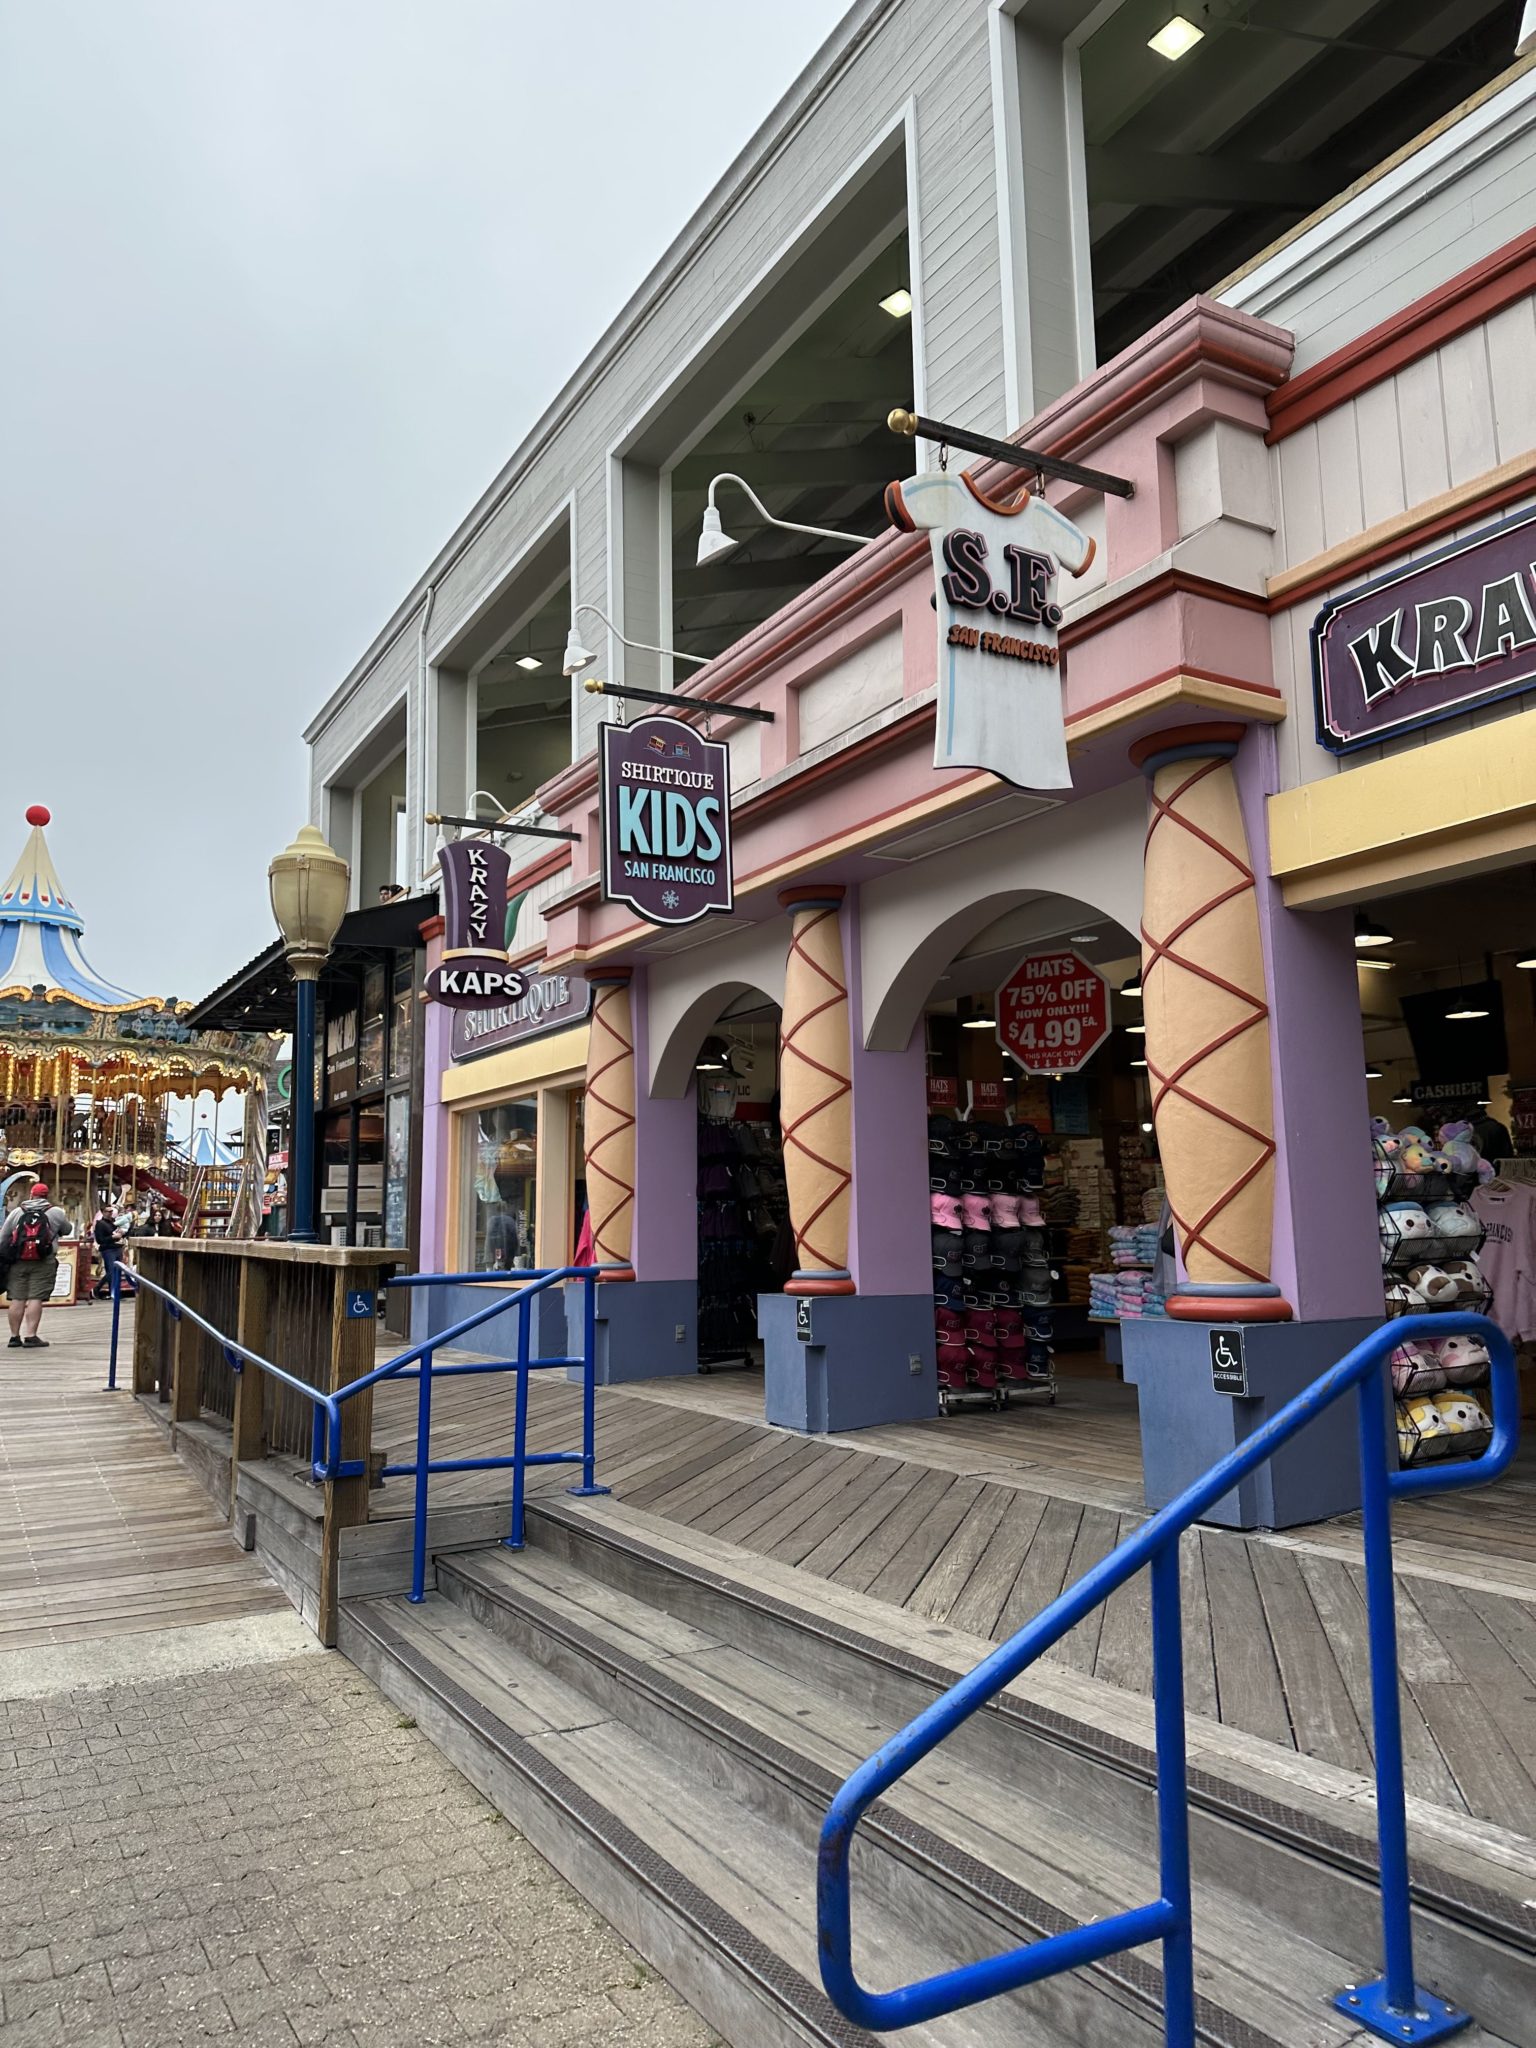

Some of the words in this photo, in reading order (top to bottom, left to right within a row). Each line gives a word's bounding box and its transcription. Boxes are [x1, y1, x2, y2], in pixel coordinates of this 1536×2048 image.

[942, 528, 1063, 628] S.F.
[947, 624, 980, 648] SAN
[980, 631, 1060, 667] FRANCISCO
[1347, 562, 1536, 704] KRA
[621, 761, 714, 790] SHIRTIQUE
[618, 784, 722, 862] KIDS
[624, 860, 649, 878] SAN
[652, 863, 715, 885] FRANCISCO
[467, 849, 488, 939] KRAZY
[1026, 958, 1075, 979] HATS
[440, 970, 522, 996] KAPS
[1007, 984, 1057, 1006] 75%
[1060, 978, 1097, 1001] OFF
[1016, 1008, 1043, 1019] NOW
[1047, 1004, 1089, 1017] ONLY!!!
[1008, 1018, 1081, 1050] $4.99
[1082, 1016, 1098, 1027] EA.
[1042, 1051, 1062, 1059] RACK
[1064, 1050, 1081, 1058] ONLY
[737, 1085, 751, 1096] LIC
[930, 1079, 949, 1090] HATS
[1414, 1081, 1483, 1099] CASHIER
[1213, 1373, 1242, 1381] ACCESSIBLE
